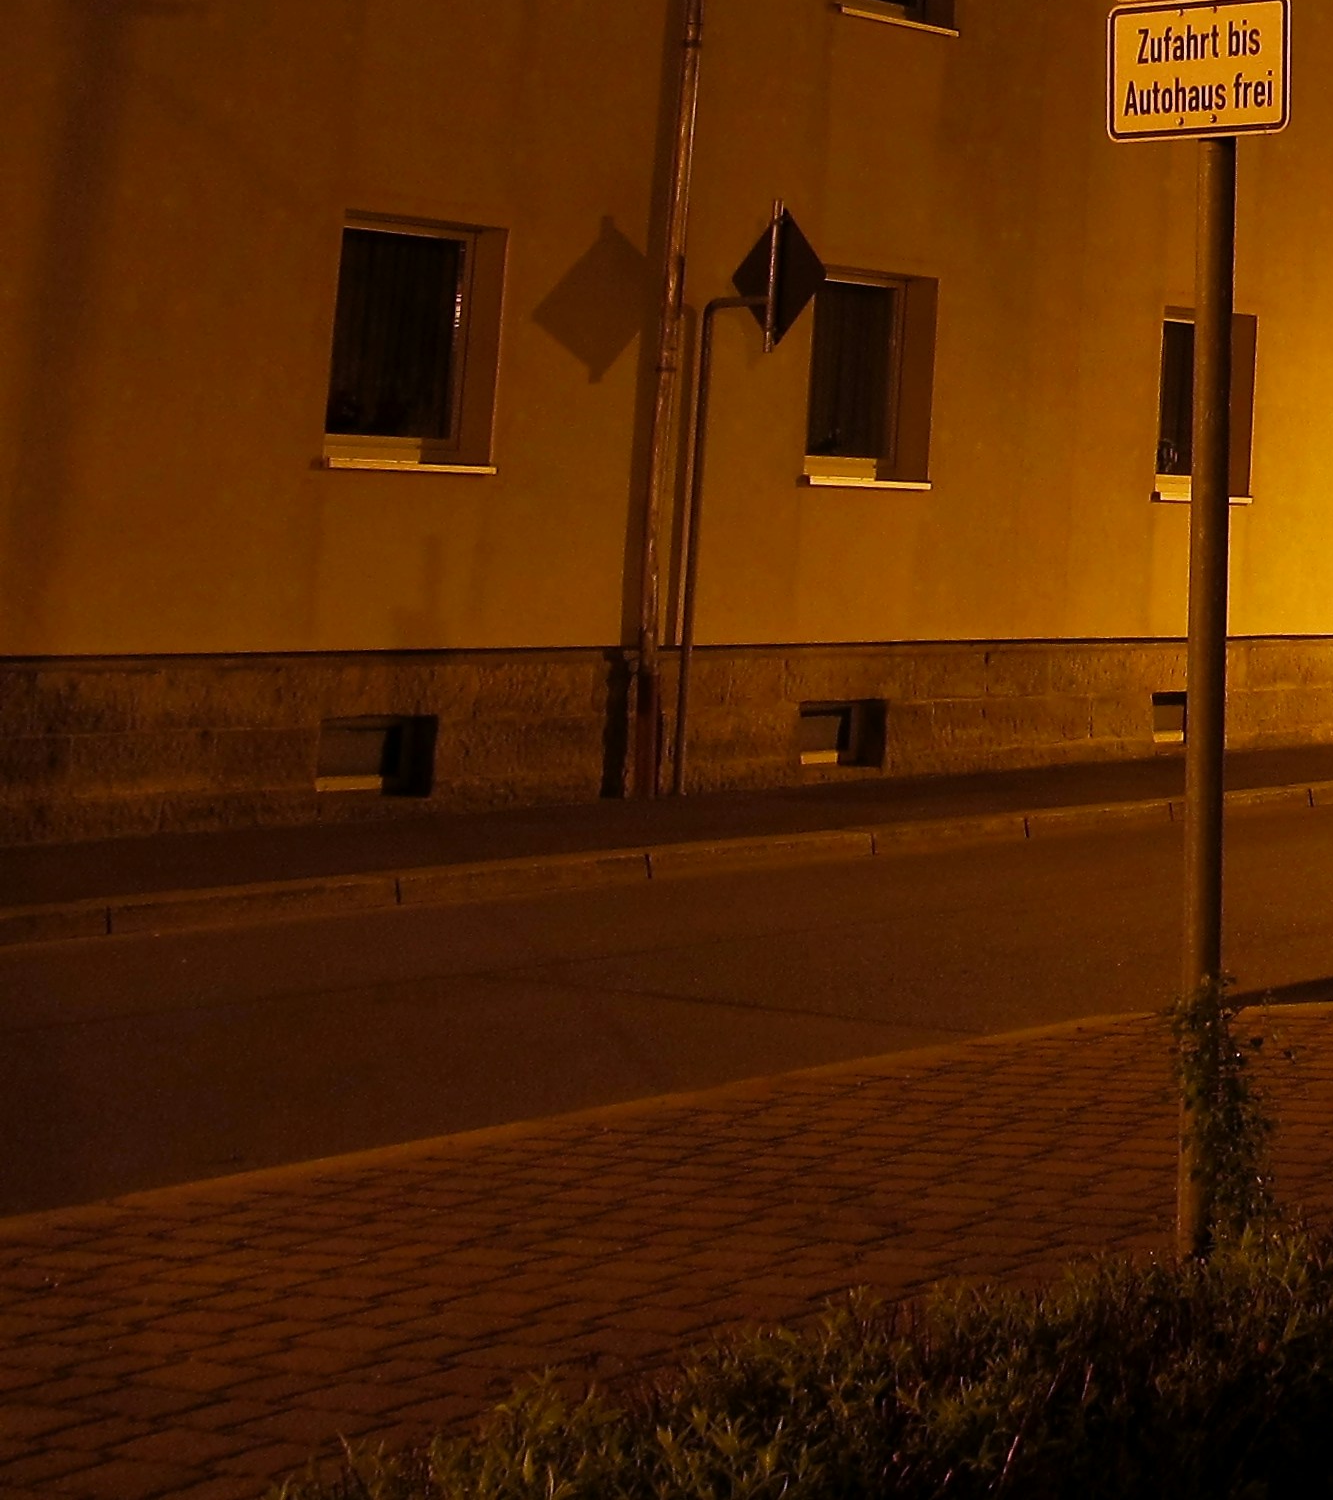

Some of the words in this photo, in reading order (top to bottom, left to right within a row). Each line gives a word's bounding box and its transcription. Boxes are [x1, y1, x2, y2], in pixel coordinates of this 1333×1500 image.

[1136, 24, 1220, 65] Zufahrt
[1227, 19, 1262, 57] bis
[1123, 77, 1227, 117] Autohaus
[1233, 69, 1274, 109] frei
